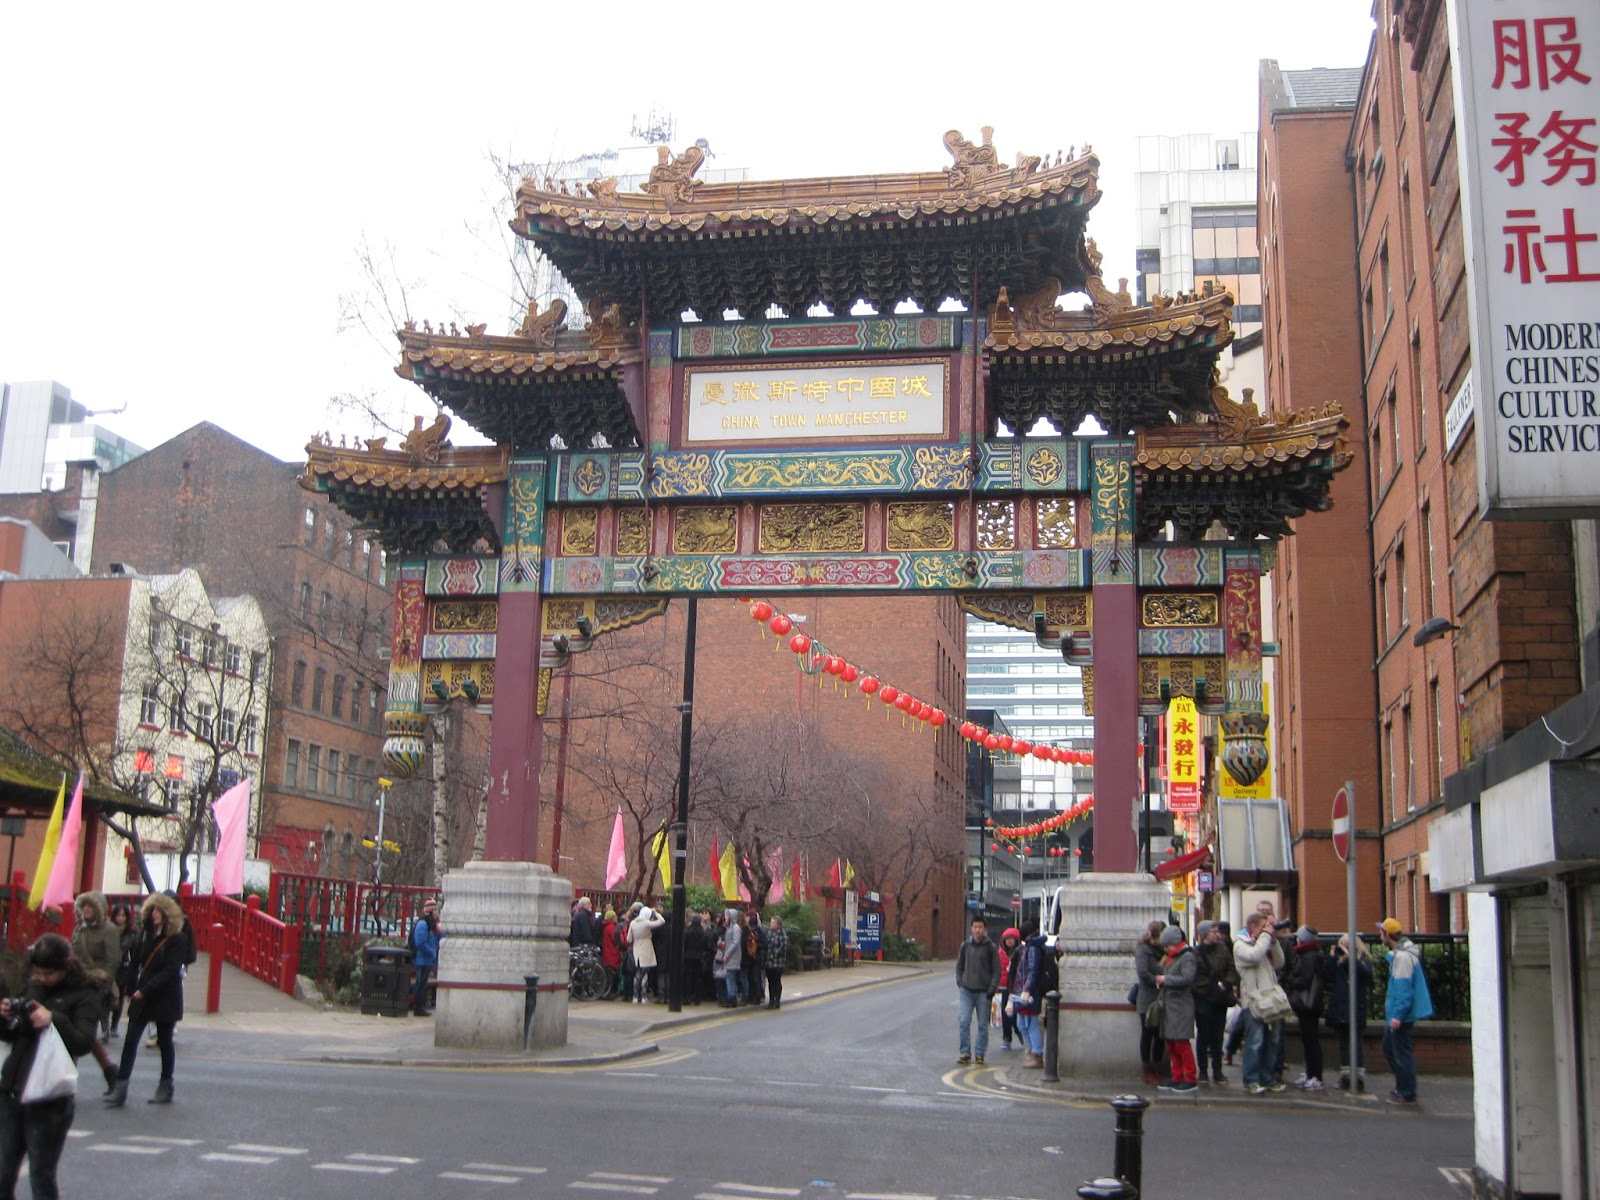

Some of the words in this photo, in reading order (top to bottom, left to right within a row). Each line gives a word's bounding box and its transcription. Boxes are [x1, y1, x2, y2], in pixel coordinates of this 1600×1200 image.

[1491, 17, 1600, 284] 服務社
[1506, 356, 1600, 384] CHINES
[1498, 390, 1600, 419] CULTUR
[722, 414, 760, 430] CHINA
[770, 413, 807, 428] TOWN
[815, 410, 909, 427] MANCHESTER
[1176, 703, 1191, 712] FAT
[1174, 718, 1195, 776] 永發行
